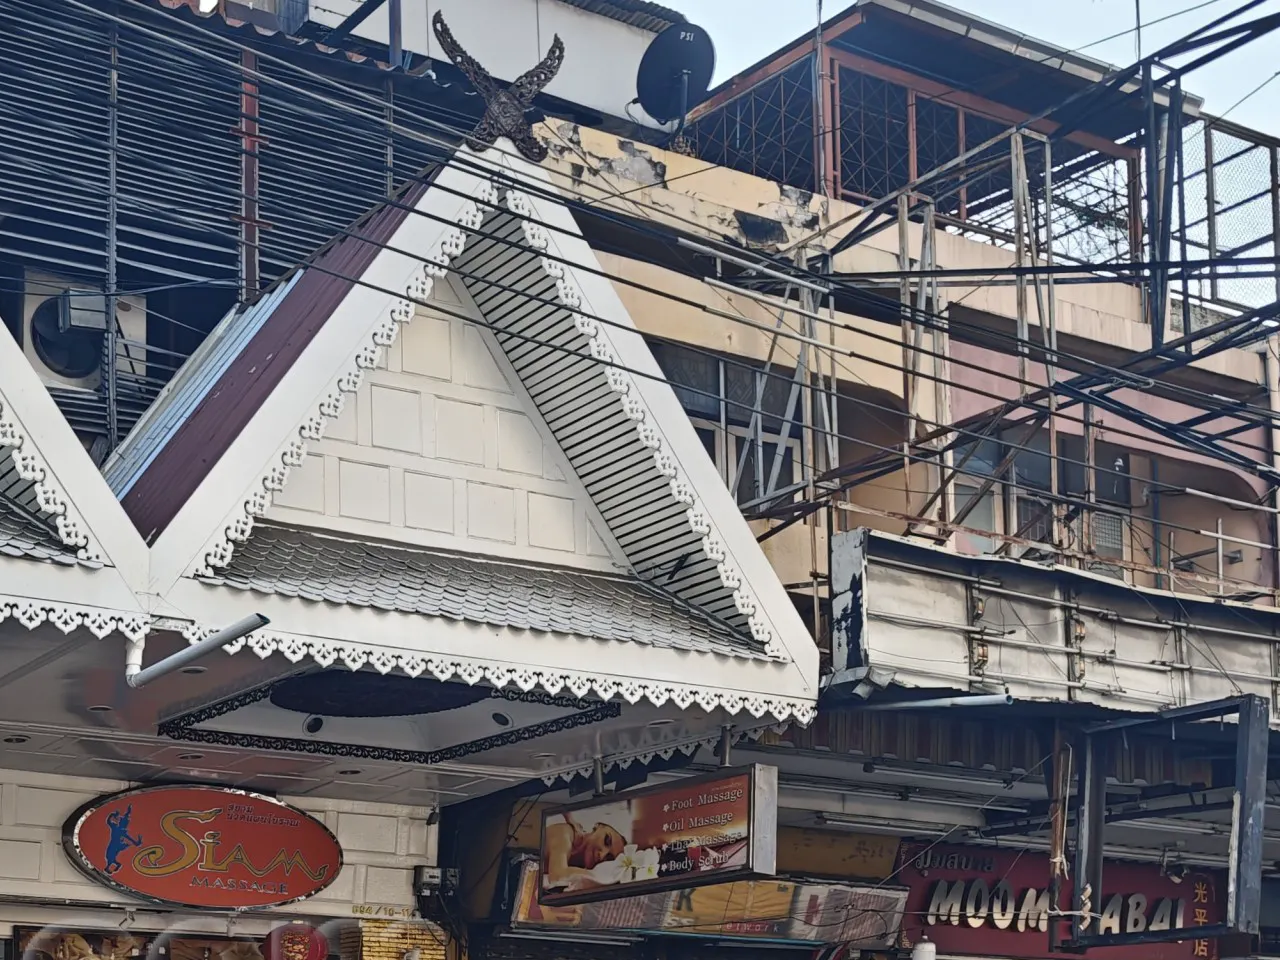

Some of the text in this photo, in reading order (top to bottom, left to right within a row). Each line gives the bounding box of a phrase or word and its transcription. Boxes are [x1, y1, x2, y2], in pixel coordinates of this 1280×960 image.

[671, 788, 743, 811] Foot Massage
[669, 812, 733, 831] Oil Massage
[669, 851, 729, 871] Body Scrub
[189, 876, 289, 895] MASSAGE
